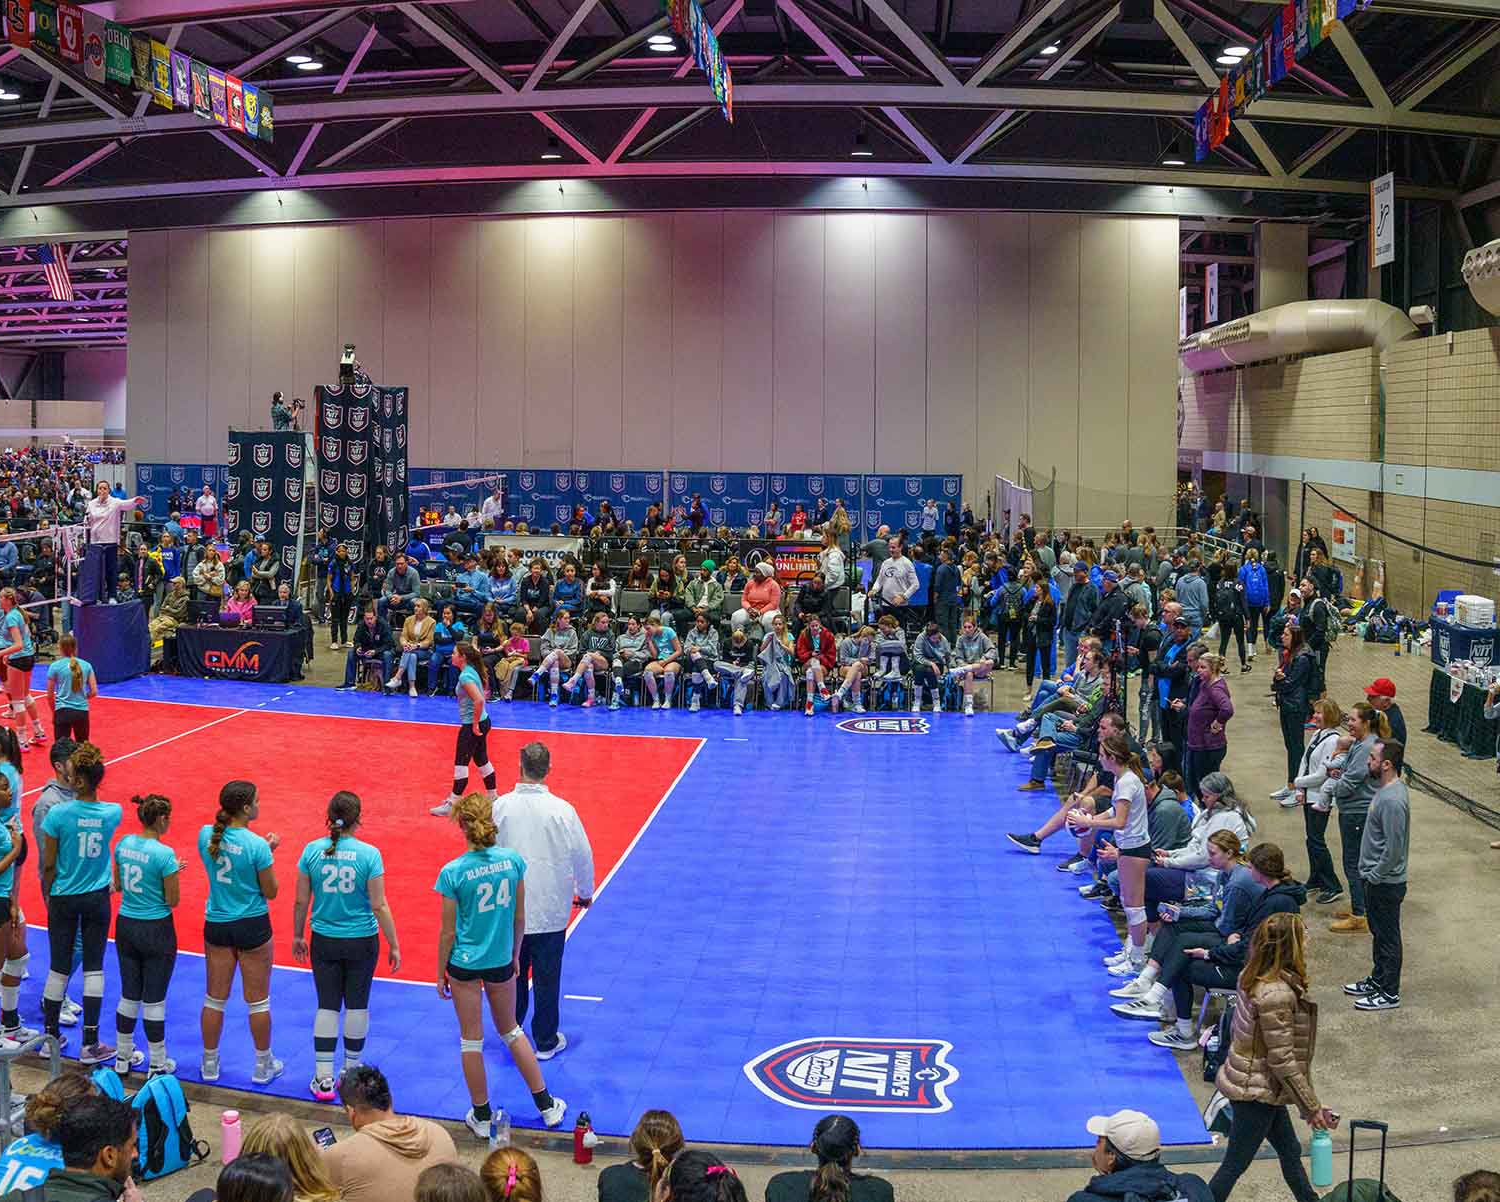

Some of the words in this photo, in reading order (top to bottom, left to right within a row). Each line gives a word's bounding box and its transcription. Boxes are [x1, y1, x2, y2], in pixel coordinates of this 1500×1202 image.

[107, 28, 130, 49] OHIO
[204, 647, 260, 672] CMM
[1472, 647, 1490, 657] NIT
[77, 831, 103, 858] 16
[123, 863, 143, 893] 12
[216, 855, 232, 884] 2
[321, 863, 356, 894] 28
[476, 878, 512, 914] 24
[839, 1049, 889, 1097] NIT
[891, 1050, 913, 1097] WOMEN'S
